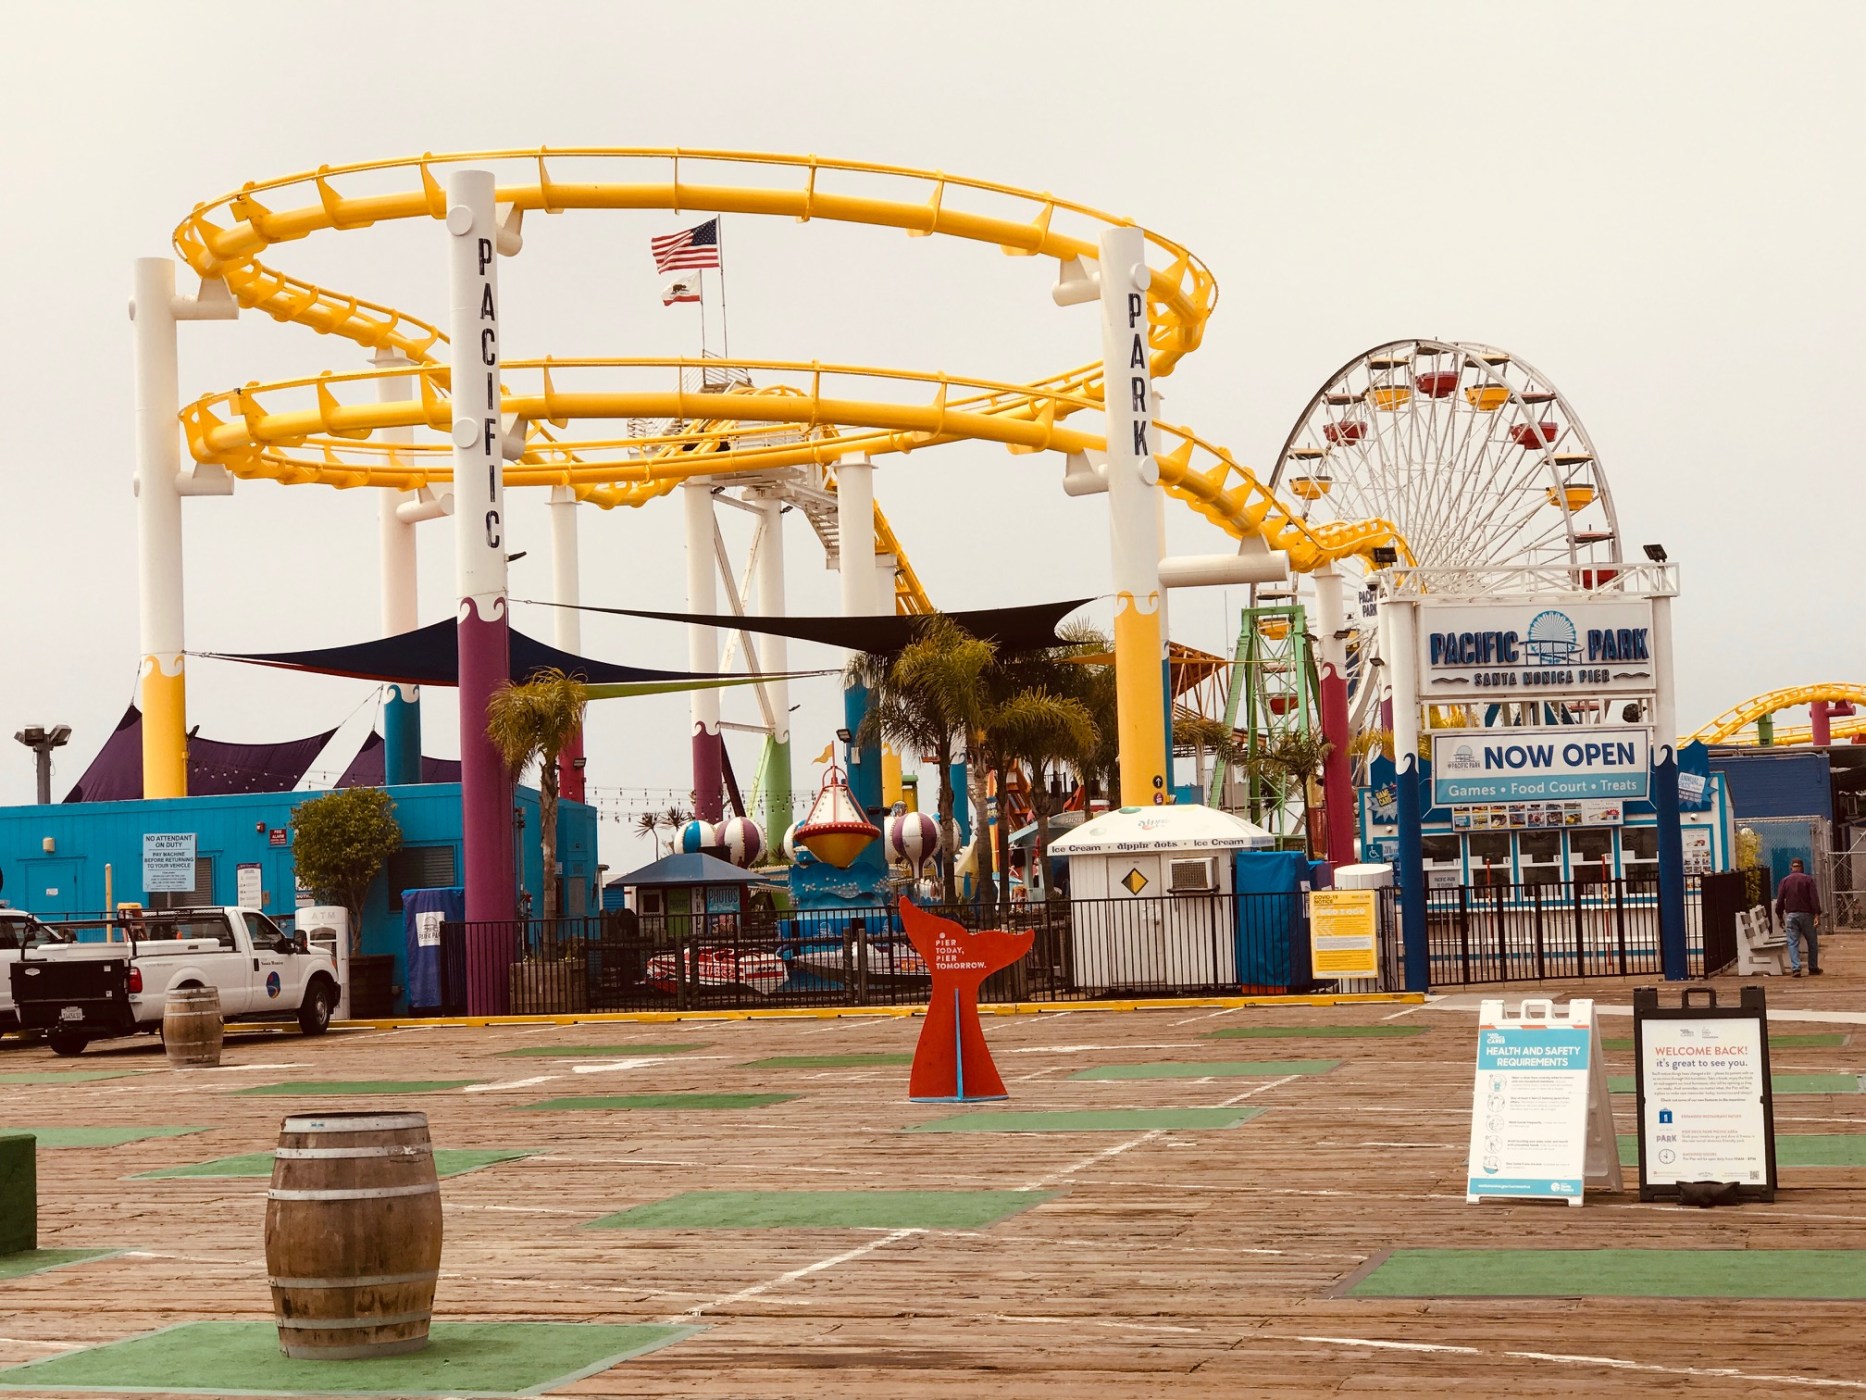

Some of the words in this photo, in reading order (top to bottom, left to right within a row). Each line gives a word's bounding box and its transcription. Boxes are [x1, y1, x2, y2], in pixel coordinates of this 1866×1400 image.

[1128, 293, 1148, 456] PARK
[478, 238, 500, 548] PACIFIC
[1430, 631, 1519, 665] PACIFIC
[1587, 628, 1649, 661] PARK
[1474, 672, 1517, 686] SANTA
[1523, 670, 1574, 685] MONICA
[1579, 669, 1610, 683] PIER
[1484, 744, 1554, 769] NOW
[1563, 742, 1635, 766] OPEN
[1448, 785, 1496, 797] Games
[1511, 782, 1544, 794] Food
[1549, 781, 1587, 792] Court
[1600, 779, 1637, 791] Treats
[1069, 844, 1102, 852] Cream
[1194, 839, 1208, 847] Ice
[1211, 838, 1244, 846] Cream
[709, 887, 738, 904] PHOTOS
[312, 911, 336, 920] ATM
[935, 946, 965, 955] TODAY,
[935, 962, 987, 970] TOMORROW.
[1486, 1047, 1521, 1056] HEALTH
[1522, 1047, 1543, 1055] AND
[1545, 1046, 1581, 1055] SAFETY
[1655, 1046, 1712, 1056] WELCOME
[1714, 1046, 1748, 1055] BACK!
[1497, 1057, 1569, 1067] REQUIREMENTS
[1656, 1058, 1670, 1067] it's
[1672, 1059, 1696, 1070] great
[1728, 1060, 1748, 1069] you.
[1656, 1134, 1677, 1143] PARK
